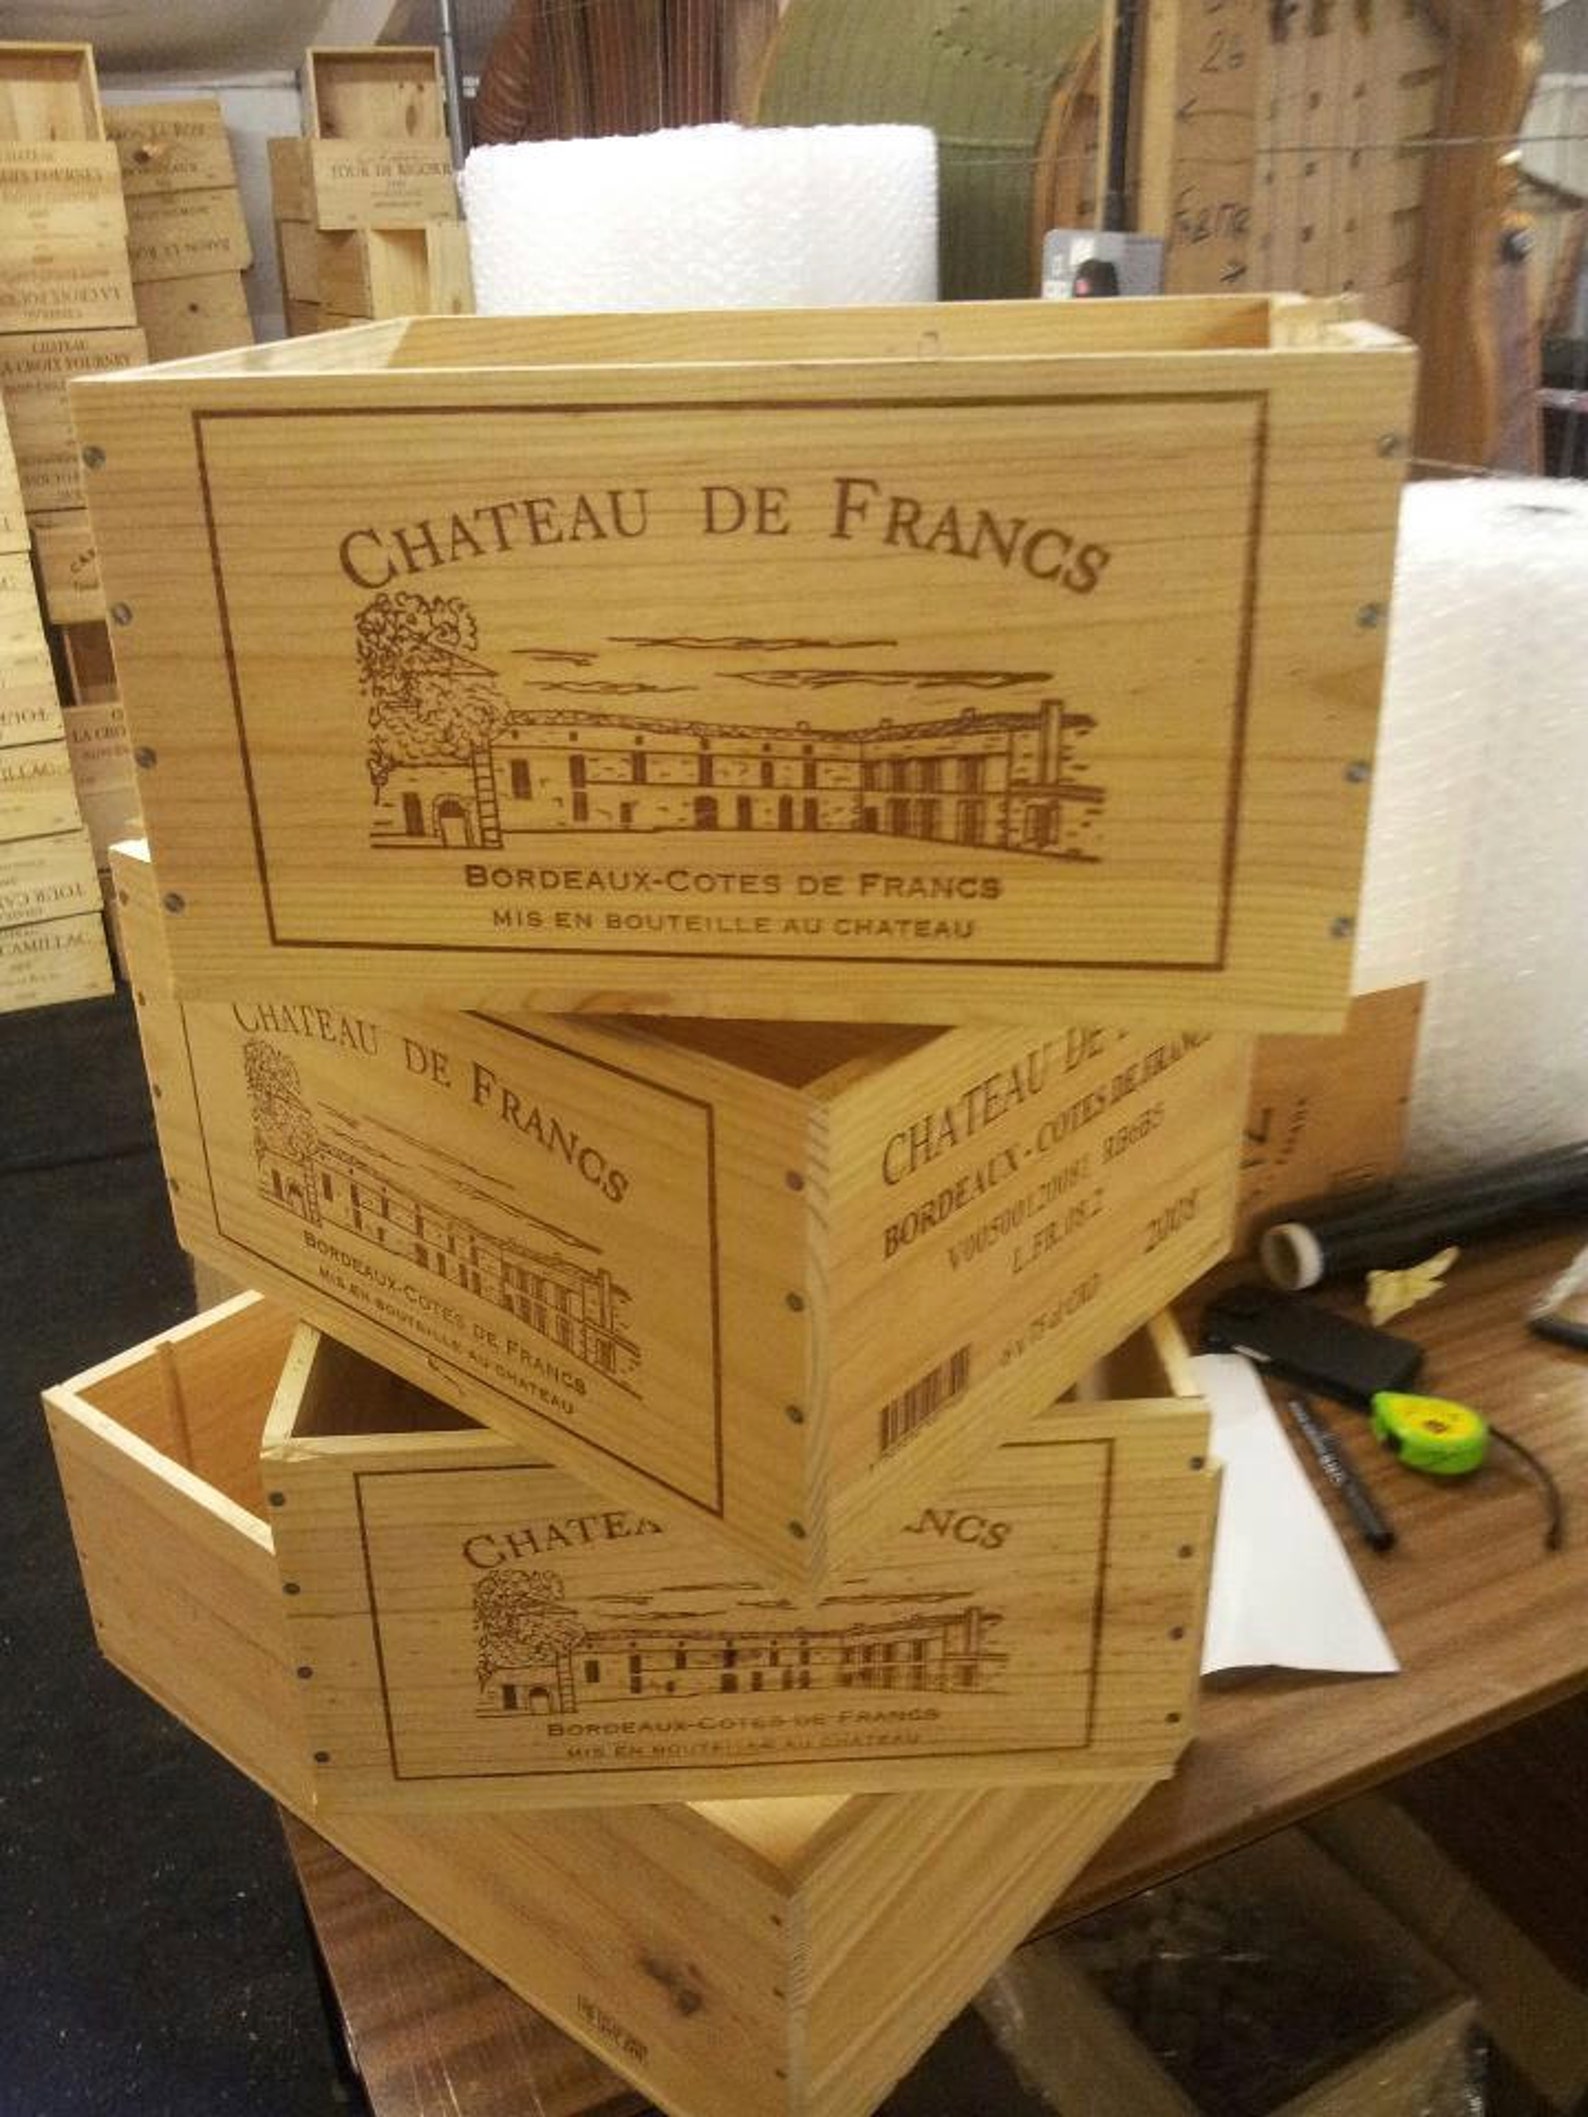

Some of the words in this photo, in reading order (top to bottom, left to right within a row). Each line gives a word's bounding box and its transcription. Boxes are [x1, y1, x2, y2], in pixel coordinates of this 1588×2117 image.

[339, 487, 650, 590] CHATEAU
[700, 486, 790, 536] DE
[829, 476, 1112, 595] FRANCS
[464, 864, 782, 895] BORDEAUX-COTES
[797, 873, 844, 898] DE
[858, 872, 1003, 900] FRANCS
[493, 909, 543, 929] MIS
[555, 911, 593, 930] EN
[606, 911, 771, 935] BOUTEILLE
[783, 917, 821, 936] AU
[833, 917, 977, 939] CHATEAU
[233, 1002, 380, 1057] CHATEAU
[403, 1037, 451, 1089] DE
[472, 1060, 630, 1205] FRANCS
[882, 1040, 1054, 1187] CHATEAU
[1062, 1026, 1105, 1074] DE
[882, 1142, 1019, 1261] BORDEAUX
[303, 1230, 465, 1330] BORDEAUX-COTES
[473, 1323, 497, 1347] DE
[506, 1338, 587, 1397] FRANCS
[319, 1265, 345, 1290] MIS
[349, 1284, 370, 1303] EN
[376, 1298, 461, 1351] BOUTEILLE
[468, 1350, 490, 1369] AU
[495, 1363, 575, 1415] CHATEAU
[462, 1509, 663, 1570] CHATEA
[901, 1508, 1013, 1550] NCS
[547, 1715, 783, 1738] BORDEAUX-COTES
[796, 1713, 825, 1728] DE
[838, 1707, 941, 1724] FRANCS
[822, 1732, 922, 1750] CHATEAU
